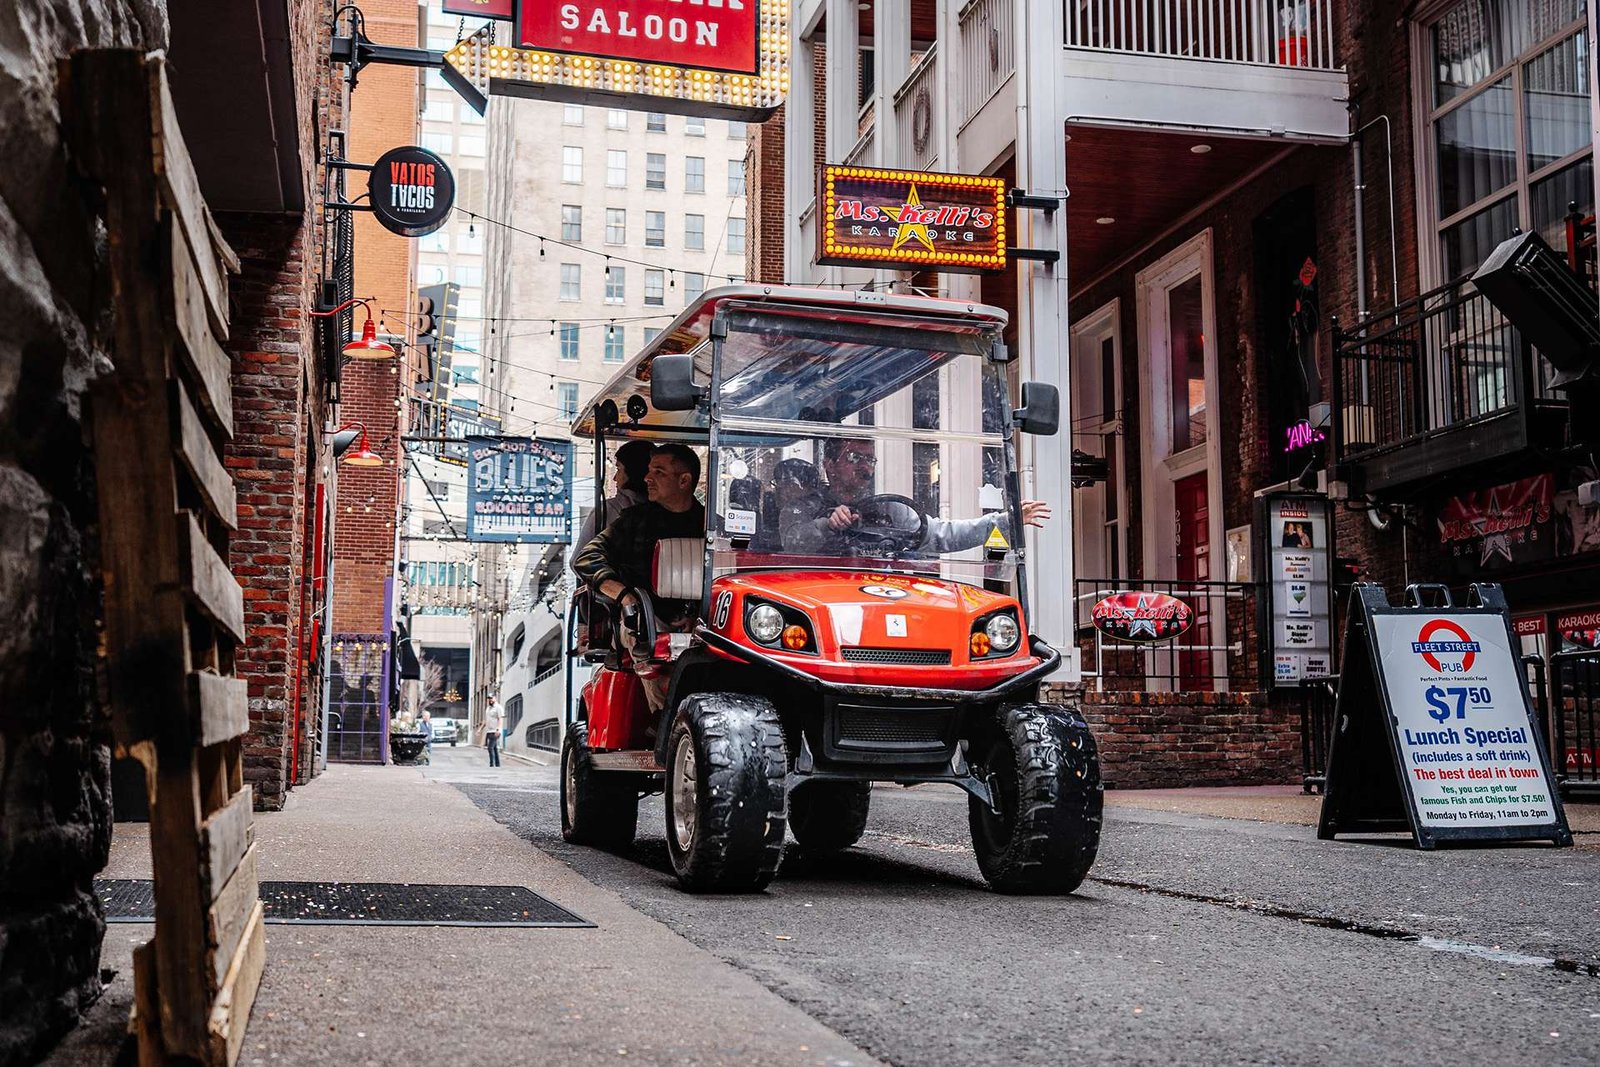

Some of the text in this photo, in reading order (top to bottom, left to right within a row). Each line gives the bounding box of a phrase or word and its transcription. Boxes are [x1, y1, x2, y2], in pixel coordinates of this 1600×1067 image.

[560, 4, 719, 47] SALOON
[390, 161, 435, 187] VATOS
[390, 184, 434, 209] TACOS
[834, 200, 890, 223] Ms.
[852, 225, 974, 242] KARAOKE
[475, 453, 564, 494] BLUES
[501, 494, 535, 502] AND
[1280, 500, 1305, 510] ATM
[475, 501, 564, 515] BOOGIE BAR
[712, 590, 733, 630] 16
[1518, 620, 1541, 632] BEST
[1559, 613, 1600, 629] KARAOKE
[1414, 643, 1478, 652] FLEET STREET
[1441, 662, 1464, 672] PUB
[1404, 727, 1528, 748] Lunch Special
[1412, 750, 1531, 765] (includes a soft drink)
[1566, 753, 1592, 764] AM
[1413, 766, 1540, 781] The best deal in town
[1441, 785, 1458, 794] Yes,
[1459, 786, 1473, 795] you
[1490, 784, 1503, 794] get
[1420, 794, 1546, 805] famous Fish and Chips for $7.50!
[1426, 809, 1549, 821] Monday to Friday, 11am to 2pm
